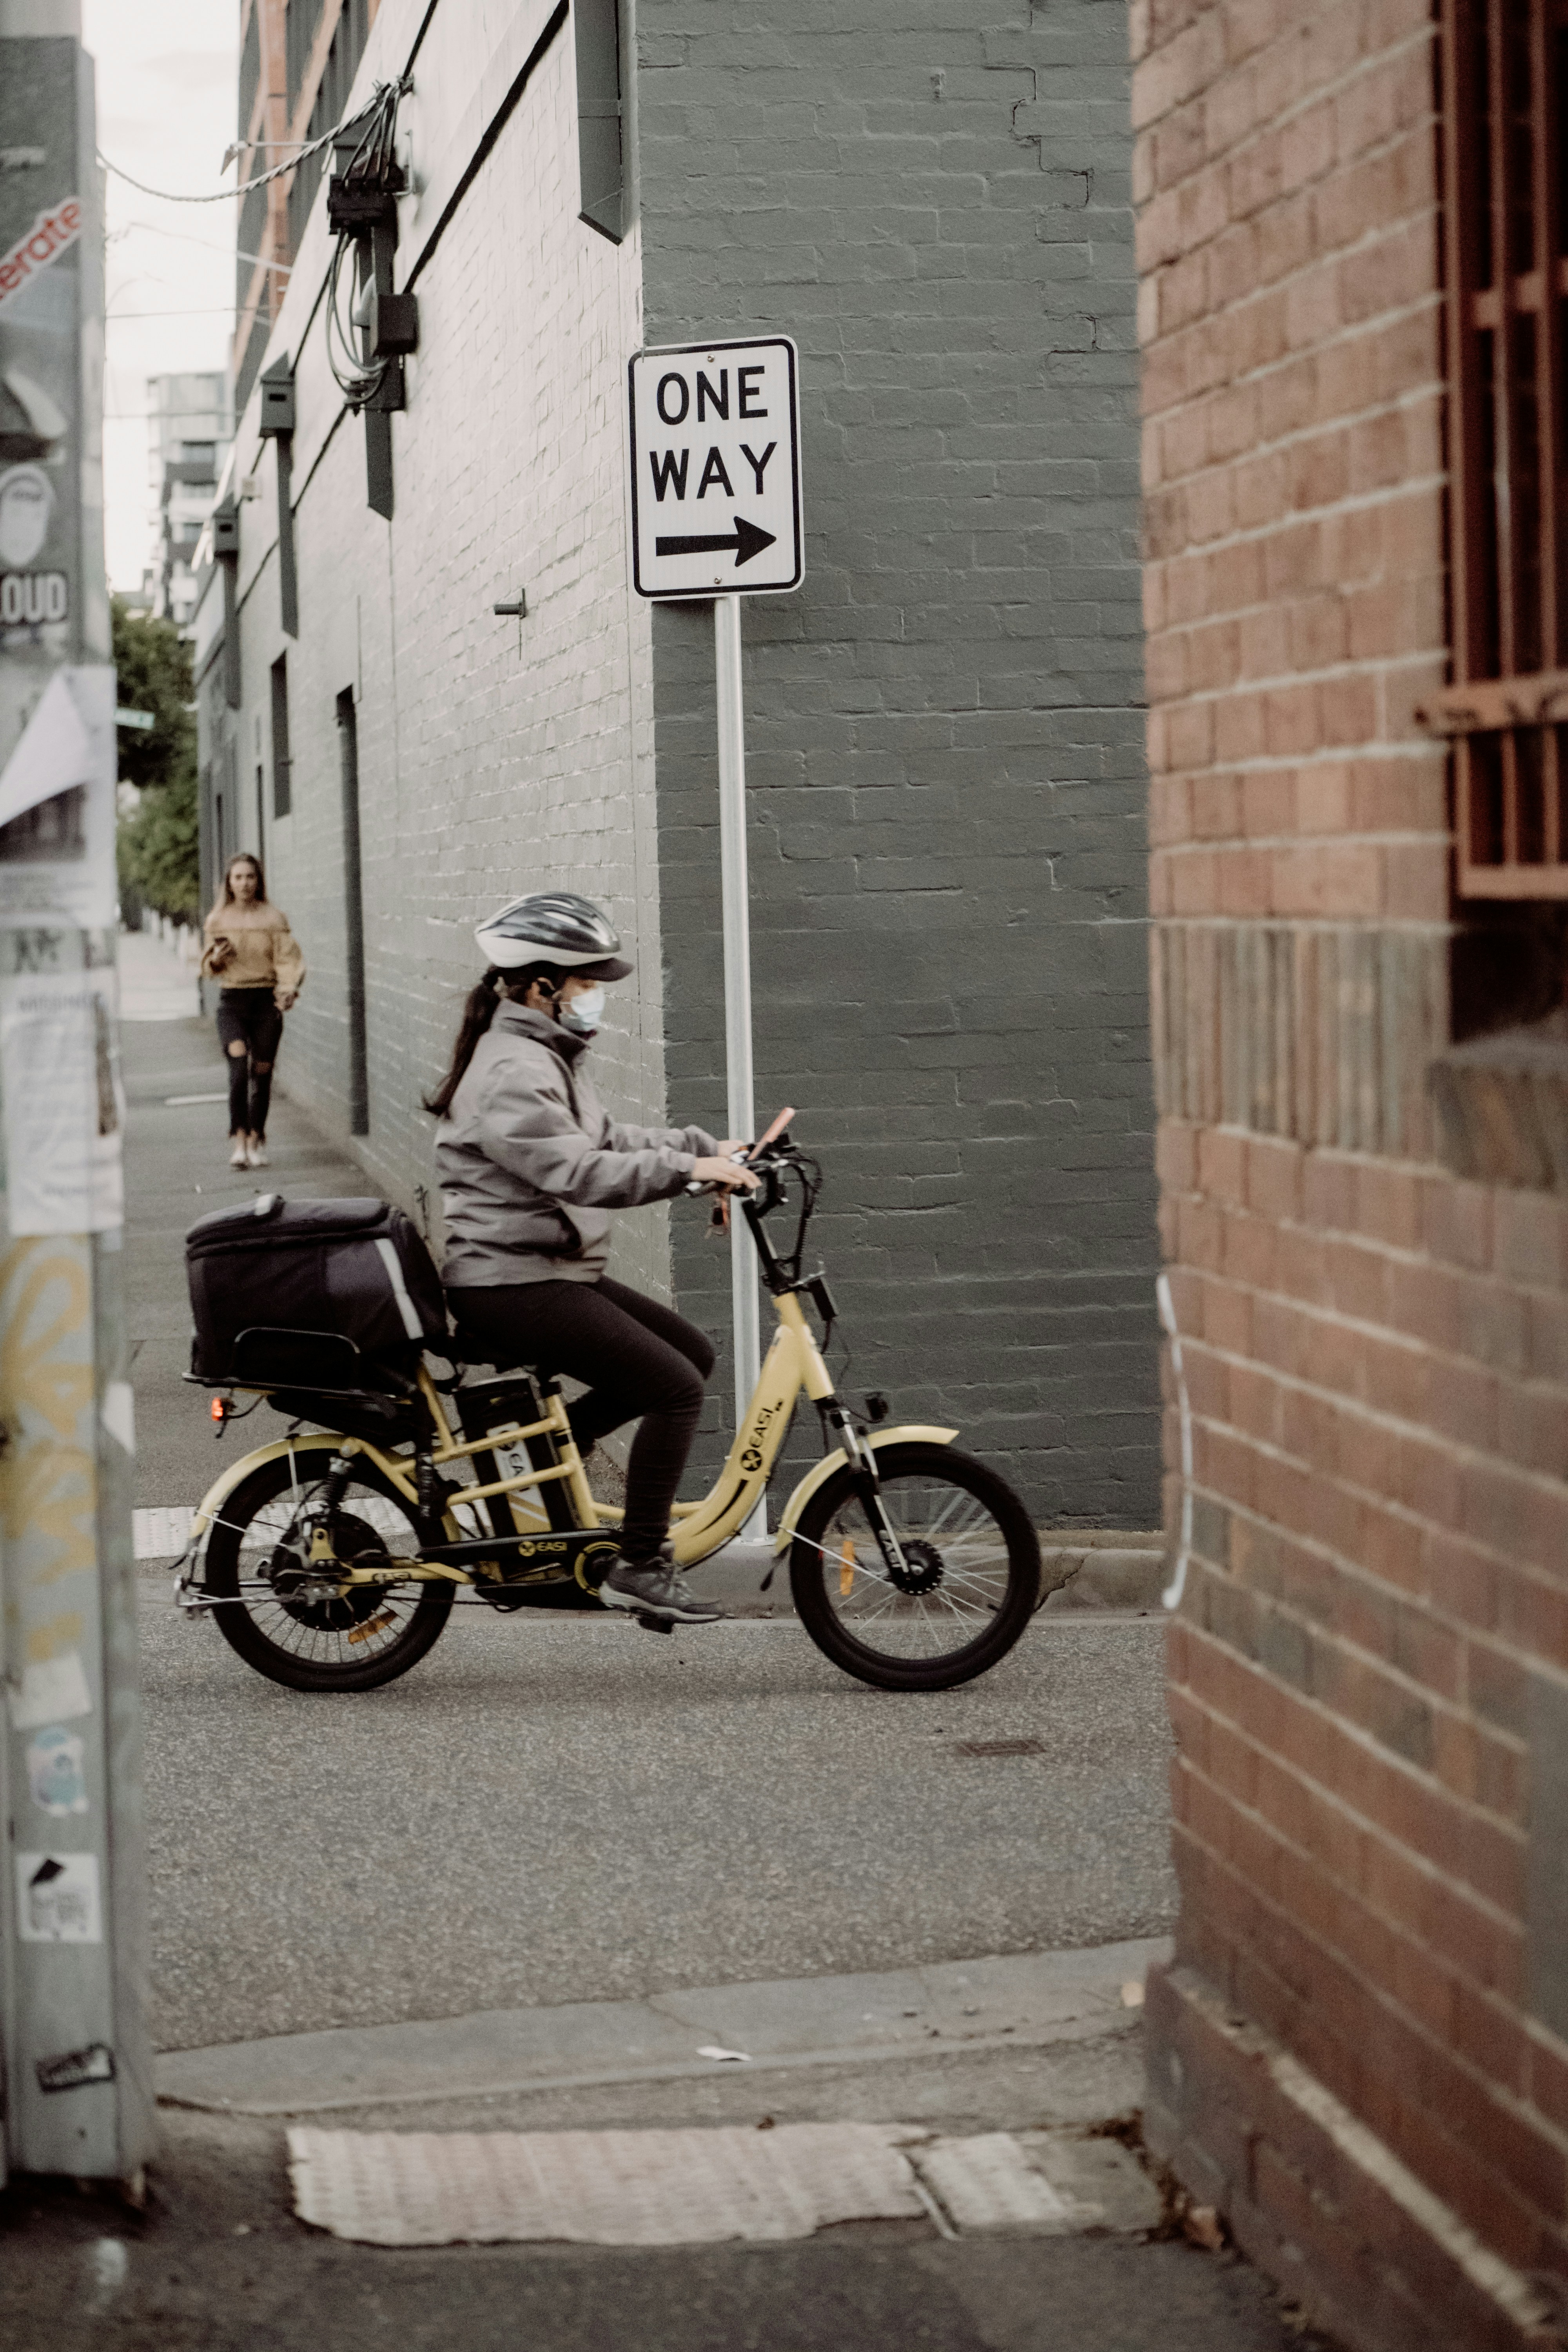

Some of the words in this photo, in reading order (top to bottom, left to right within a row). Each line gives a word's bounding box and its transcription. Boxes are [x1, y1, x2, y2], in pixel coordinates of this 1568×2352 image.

[0, 201, 81, 301] erate
[657, 365, 768, 425] ONE
[649, 442, 777, 502] WAY
[748, 1408, 774, 1448] EASI
[510, 1453, 530, 1492] EAI
